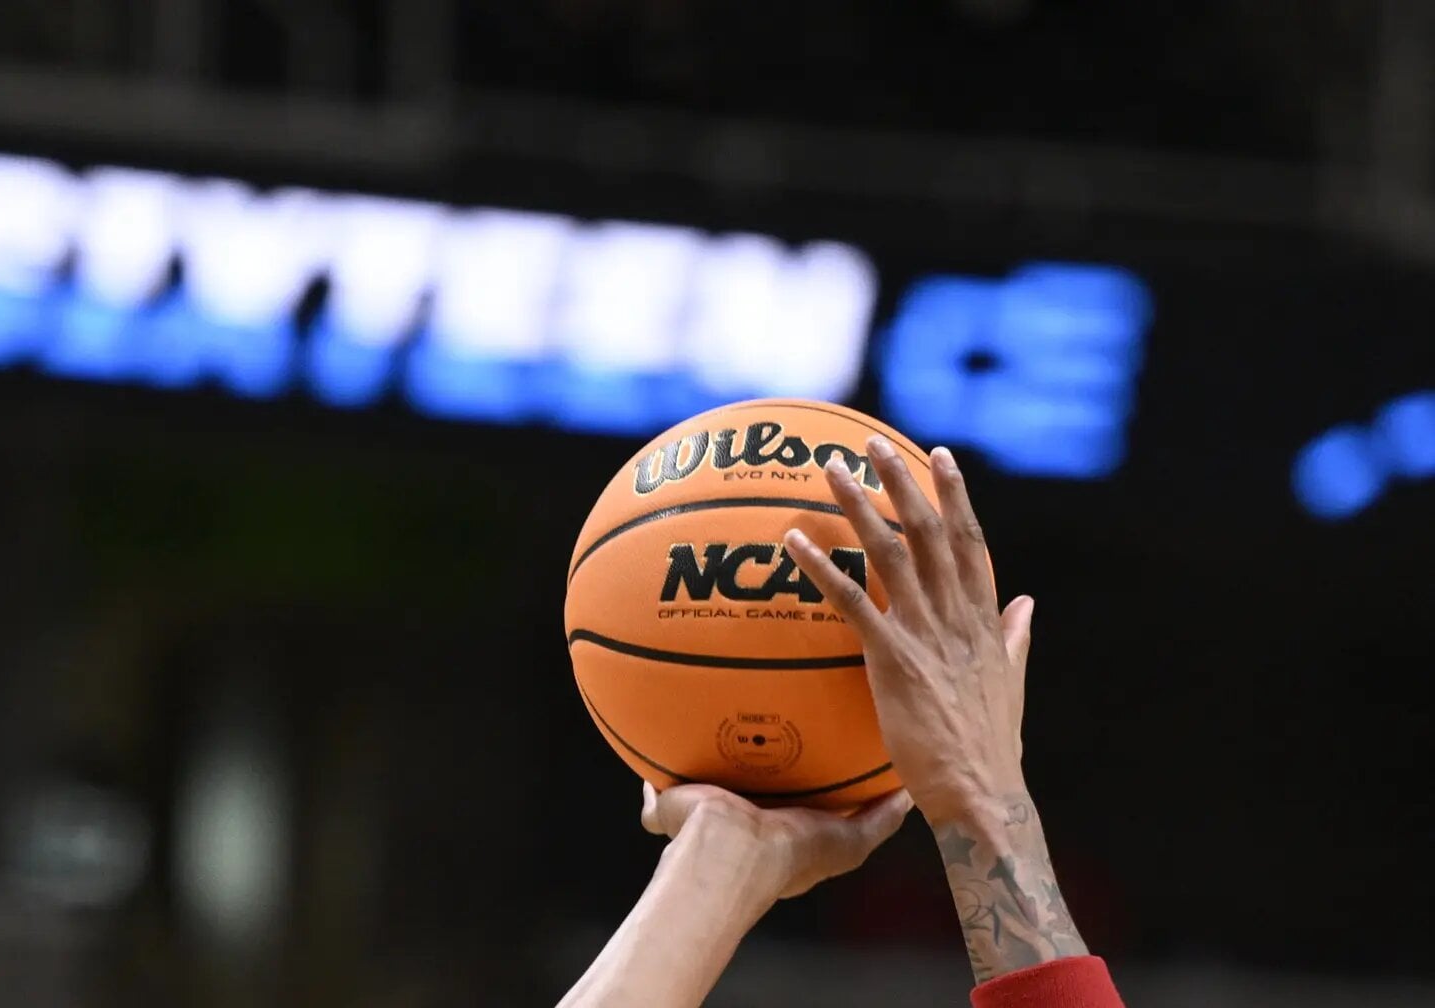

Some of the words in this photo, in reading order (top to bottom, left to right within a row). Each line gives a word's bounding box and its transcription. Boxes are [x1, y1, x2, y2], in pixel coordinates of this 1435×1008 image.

[723, 471, 763, 481] EVO
[771, 471, 812, 482] NXT
[660, 543, 867, 604] NCAA
[658, 608, 740, 619] OFFICIAL
[746, 608, 806, 620] GAME
[811, 611, 845, 624] BA
